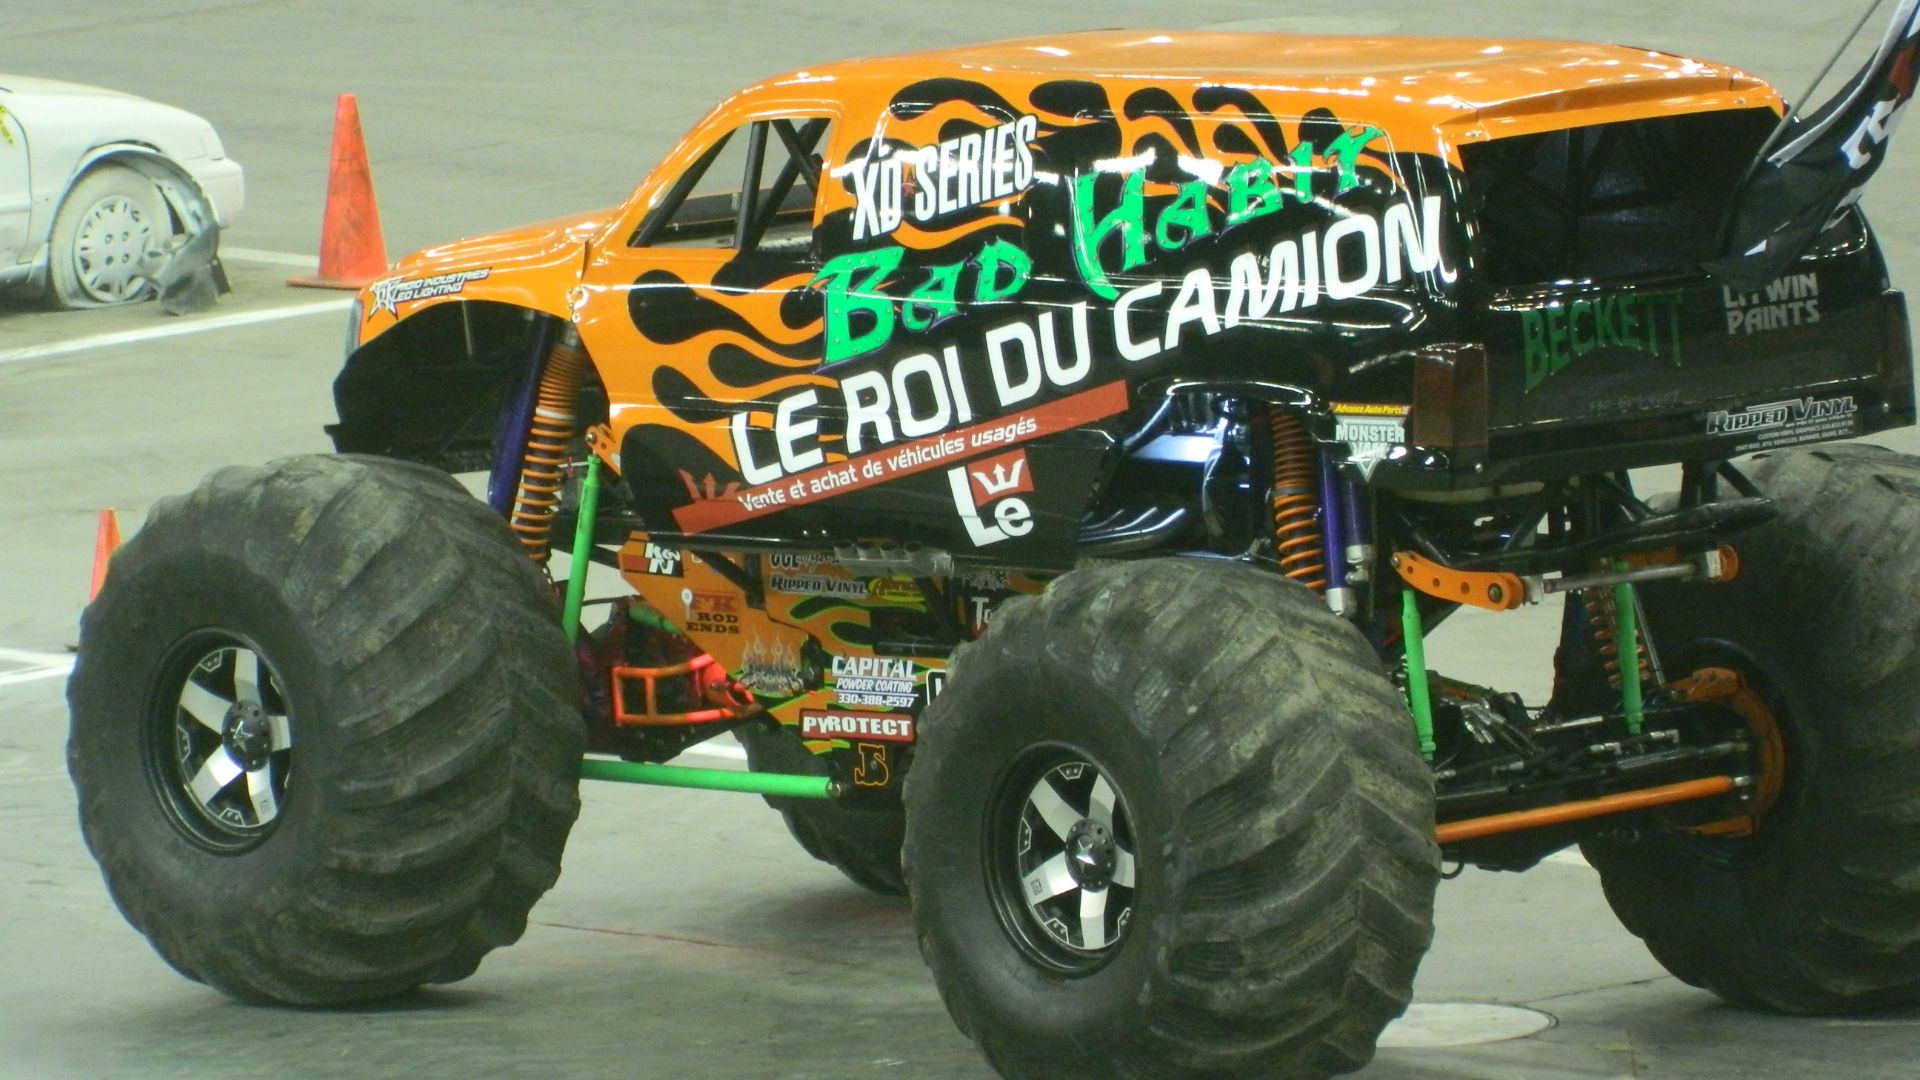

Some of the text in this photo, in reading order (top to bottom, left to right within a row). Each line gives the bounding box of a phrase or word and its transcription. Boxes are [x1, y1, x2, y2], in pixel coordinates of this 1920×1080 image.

[915, 115, 1038, 221] SERIES
[805, 122, 1387, 368] BAD HABIT
[413, 283, 463, 299] LIGHTING
[1723, 272, 1818, 308] LWIN
[1726, 299, 1820, 335] PAINTS
[731, 196, 1457, 486] LE ROI DU CAMION
[1519, 288, 1684, 394] BECKETT
[1364, 404, 1383, 414] Auto
[1383, 405, 1402, 415] Parts
[1706, 407, 1788, 436] RIPPED
[1791, 396, 1858, 420] VINYL
[1335, 424, 1405, 443] MONSTER
[738, 416, 1037, 512] Vente et achat de véhicules usagés
[770, 573, 822, 592] RIPPED
[825, 577, 867, 595] VINYL
[685, 622, 739, 634] ENDS
[697, 612, 739, 623] ROD
[832, 655, 918, 680] CAPITAL
[836, 677, 913, 694] POWDER COATING
[803, 714, 911, 737] PYROTECT
